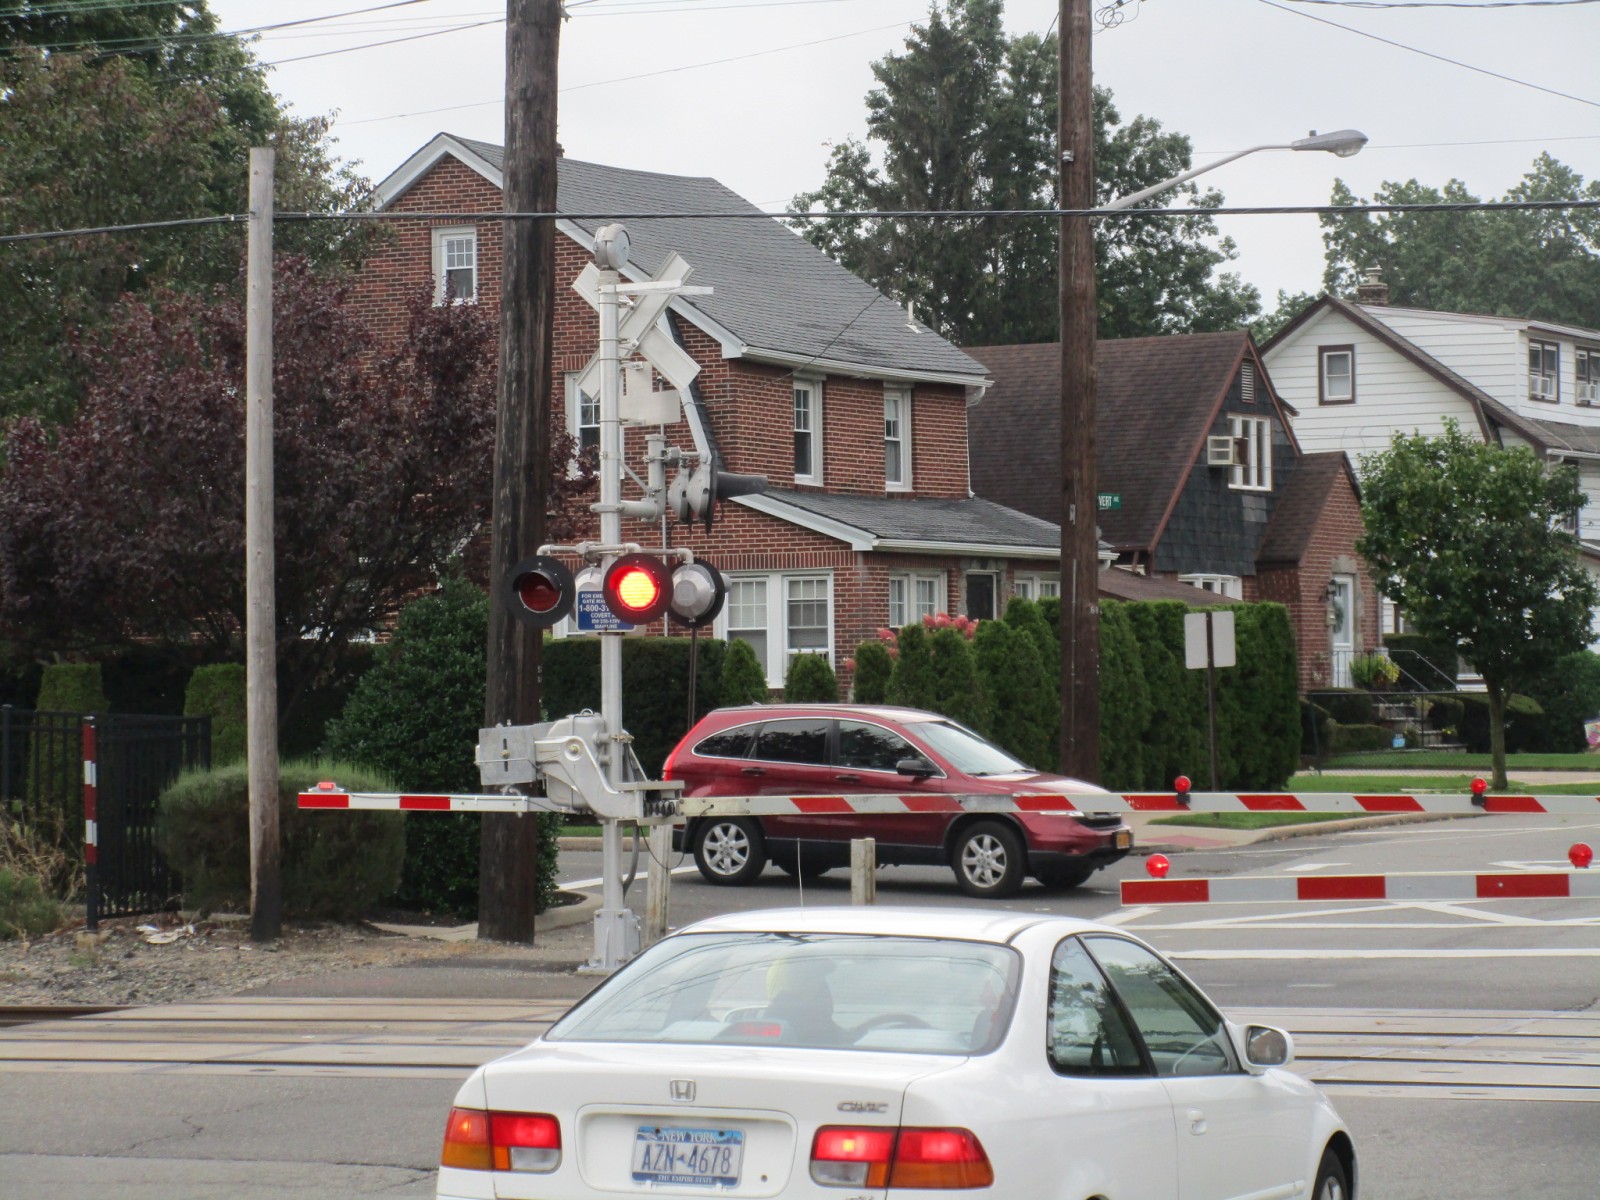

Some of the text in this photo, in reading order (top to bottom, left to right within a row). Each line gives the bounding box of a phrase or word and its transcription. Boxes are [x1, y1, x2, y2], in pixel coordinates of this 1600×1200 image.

[662, 1130, 718, 1144] NEW YORK
[671, 1175, 695, 1183] EMPIRE
